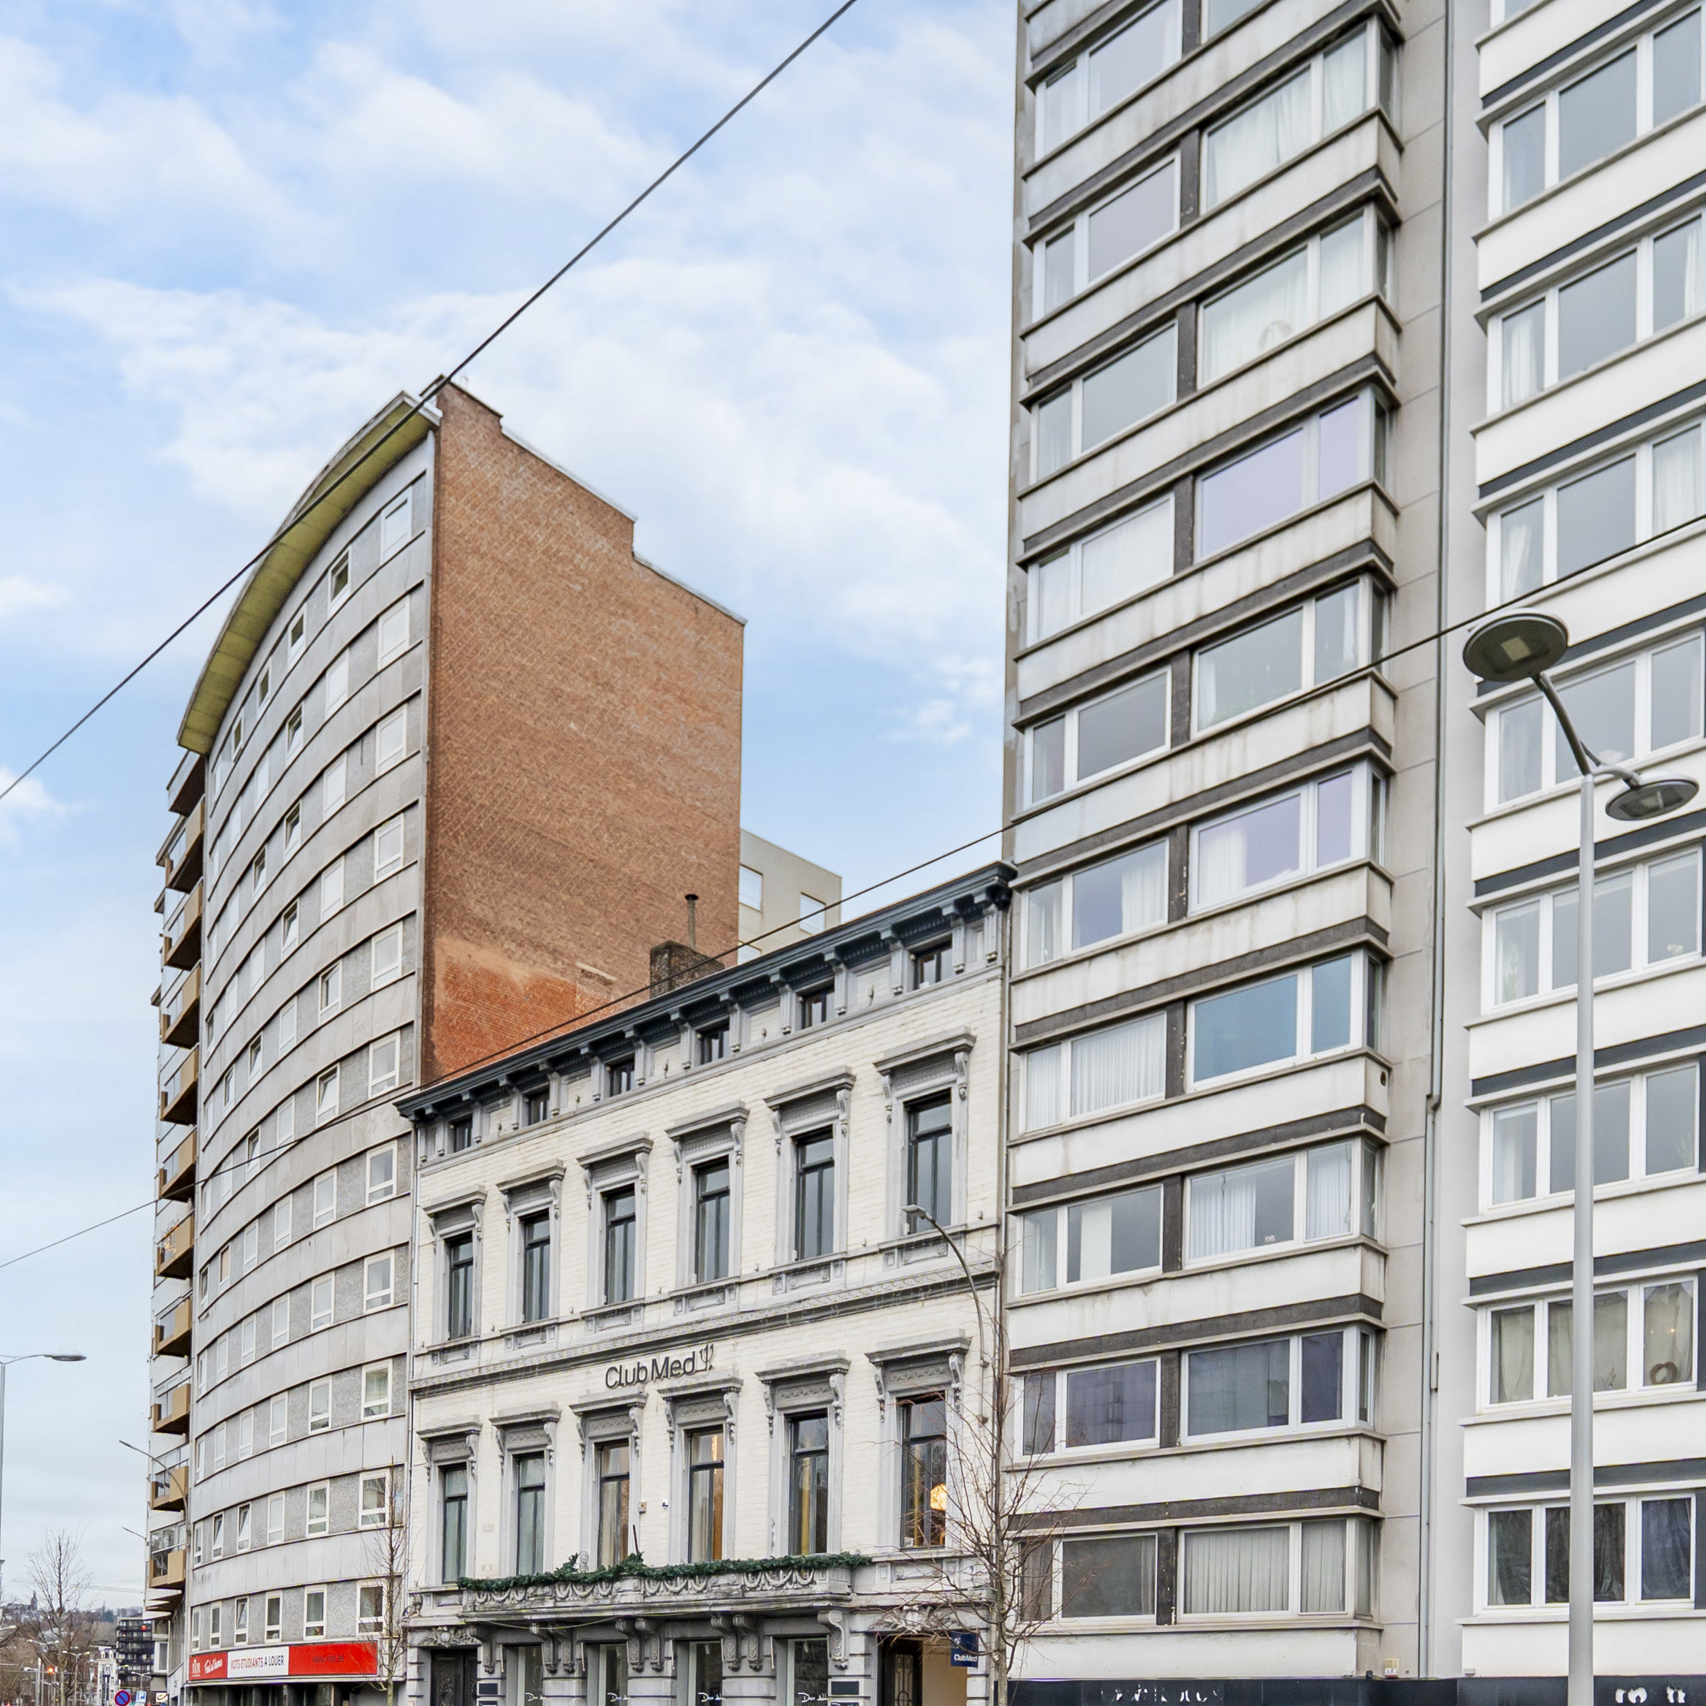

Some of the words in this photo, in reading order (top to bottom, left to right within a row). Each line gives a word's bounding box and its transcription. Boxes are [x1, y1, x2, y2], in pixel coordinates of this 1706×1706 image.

[605, 1361, 648, 1389] Club
[651, 1351, 696, 1381] Med
[240, 1656, 264, 1669] ETUDIANTS
[264, 1656, 268, 1667] A
[268, 1654, 285, 1667] LOUER
